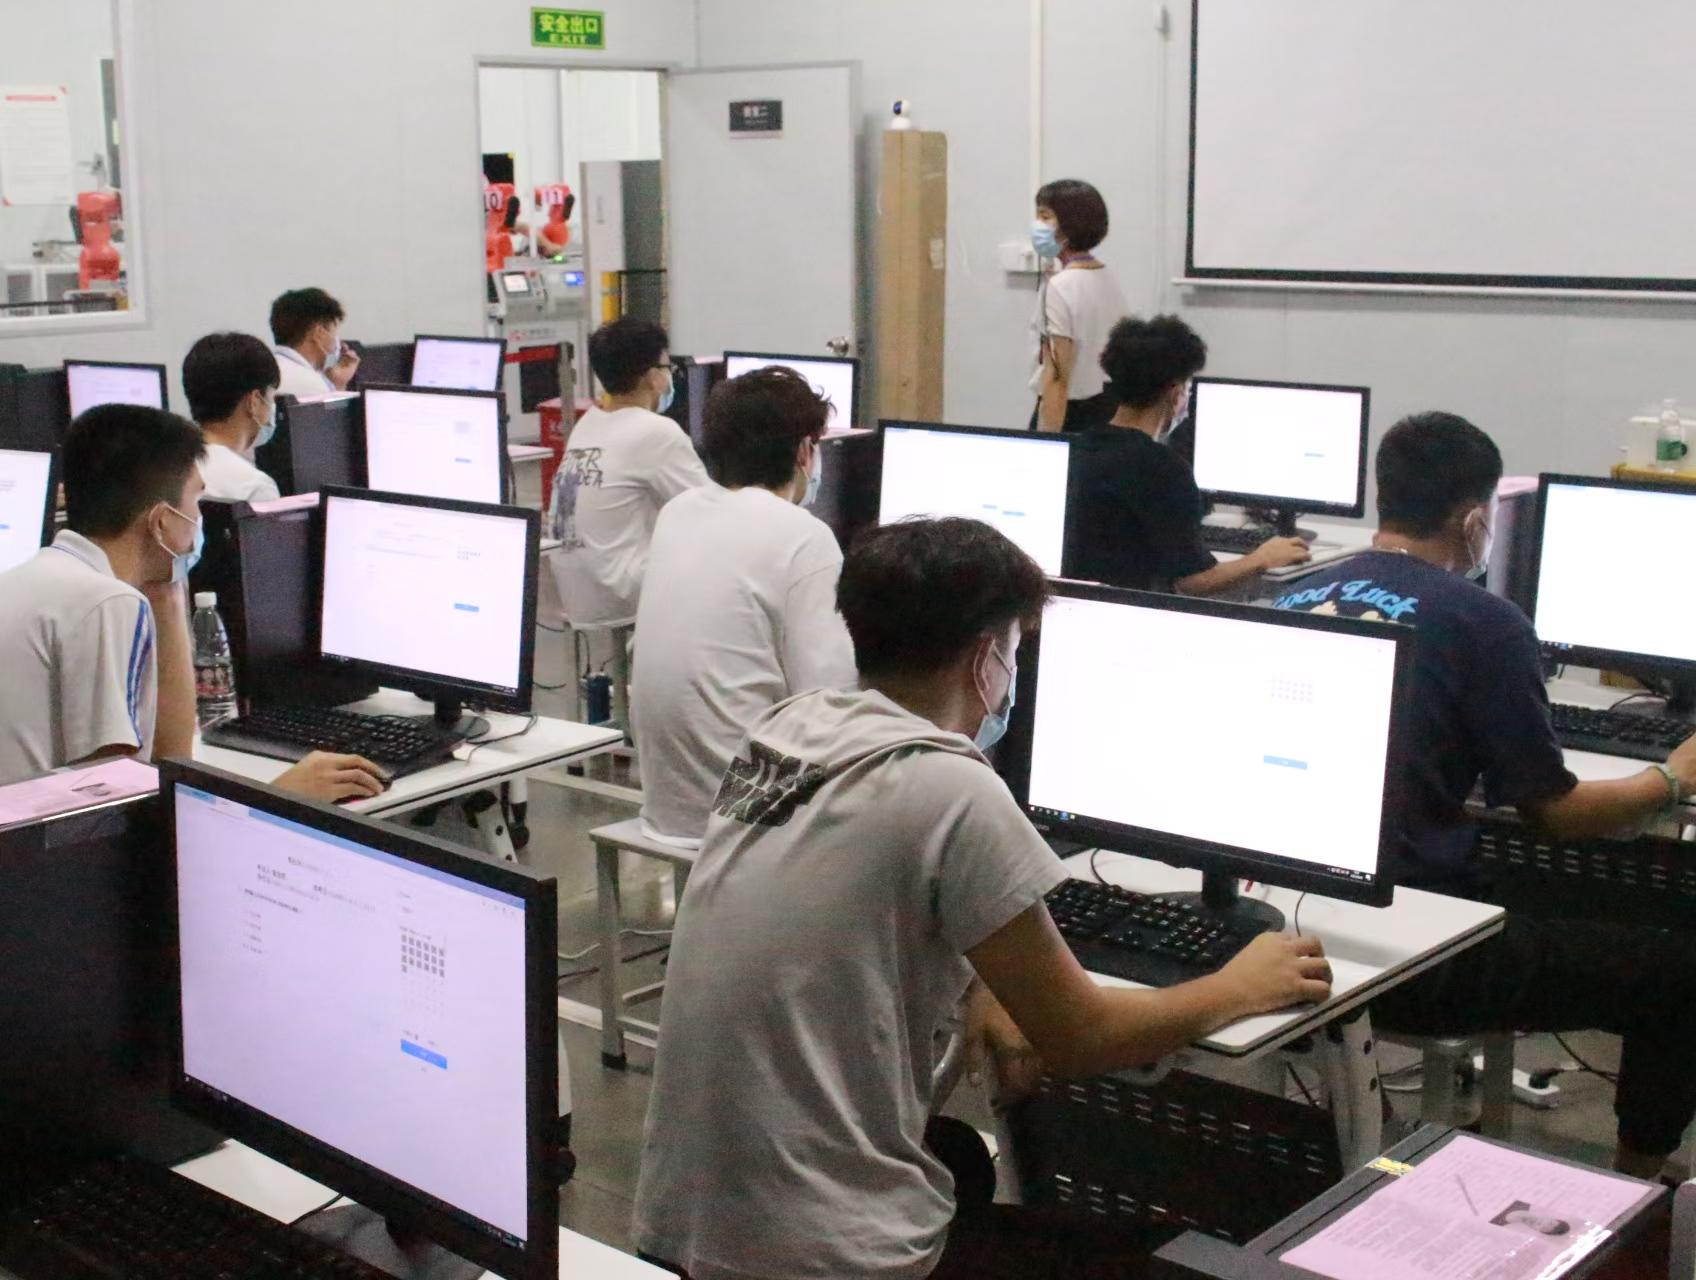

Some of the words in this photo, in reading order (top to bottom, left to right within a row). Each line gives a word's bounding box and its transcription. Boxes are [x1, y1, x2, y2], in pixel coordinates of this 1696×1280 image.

[540, 14, 598, 33] 安全出口
[550, 34, 586, 44] EXIT
